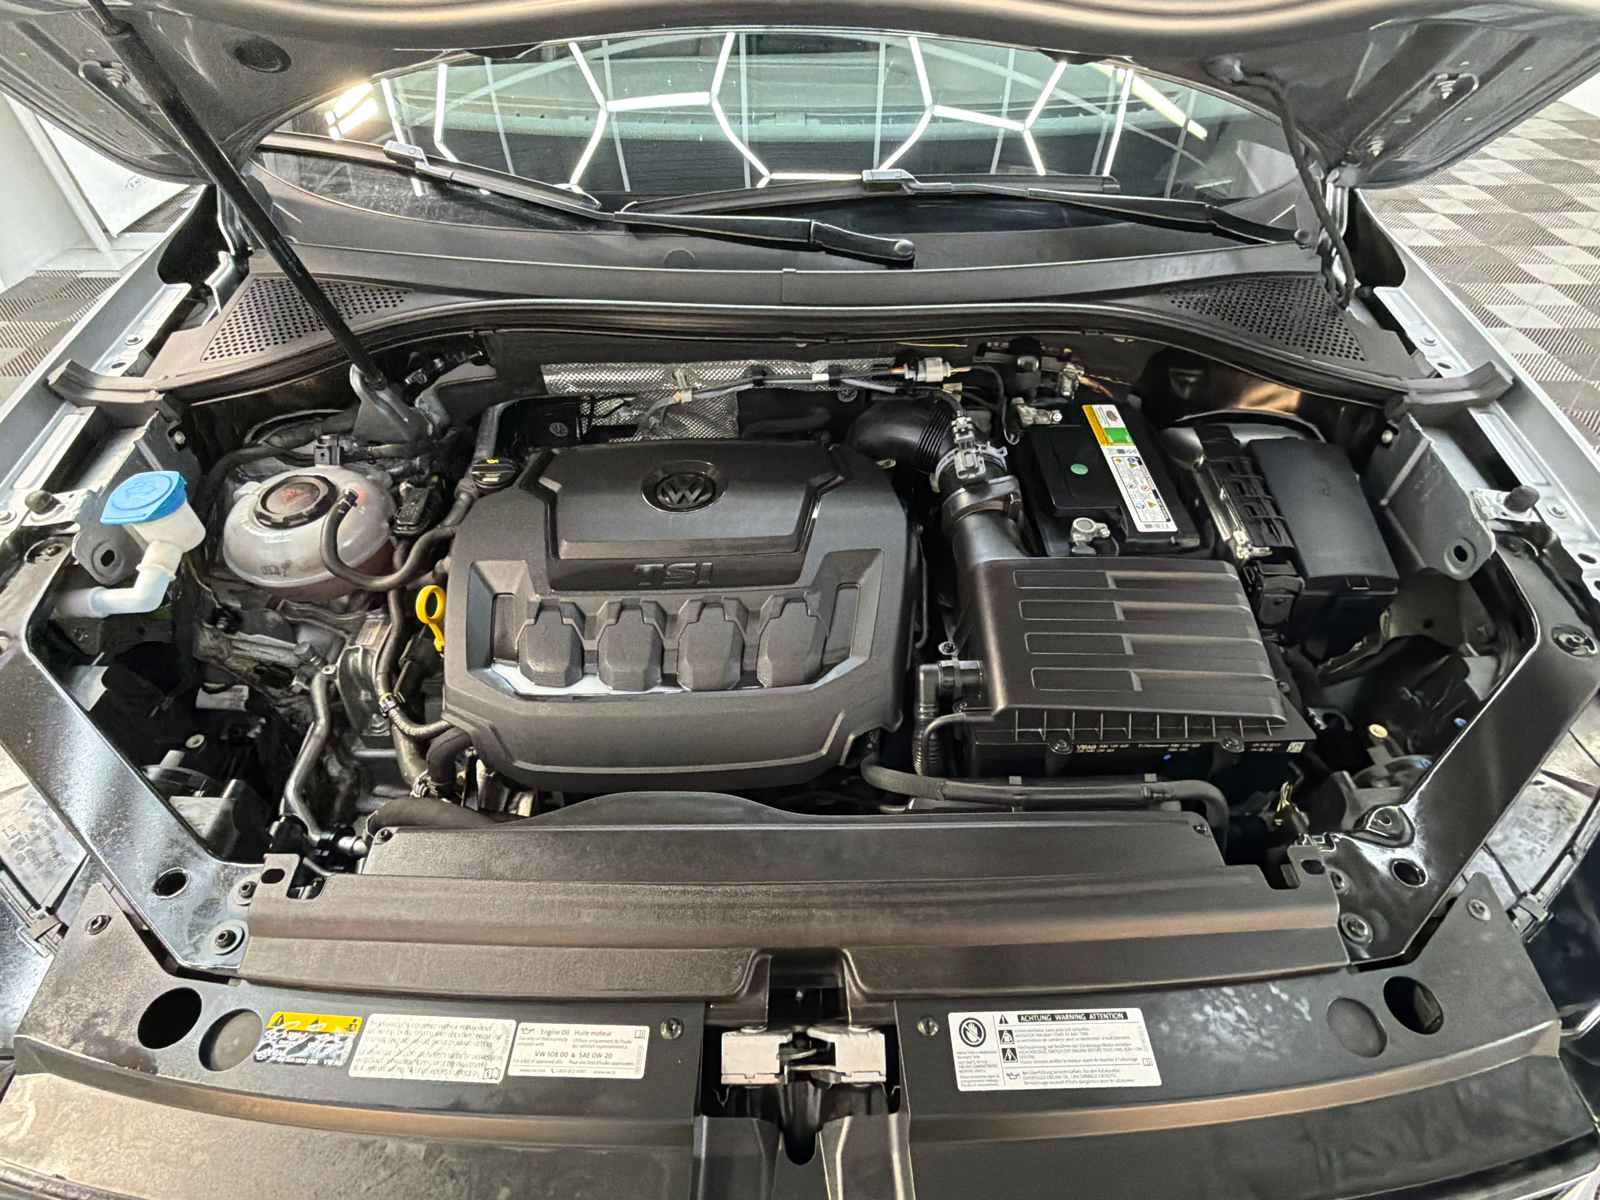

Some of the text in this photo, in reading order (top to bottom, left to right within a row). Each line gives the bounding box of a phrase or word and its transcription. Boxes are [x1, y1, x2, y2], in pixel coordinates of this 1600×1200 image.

[633, 563, 714, 586] TSI
[1054, 1013, 1086, 1021] WARNING
[1089, 1012, 1124, 1020] ATTENTION
